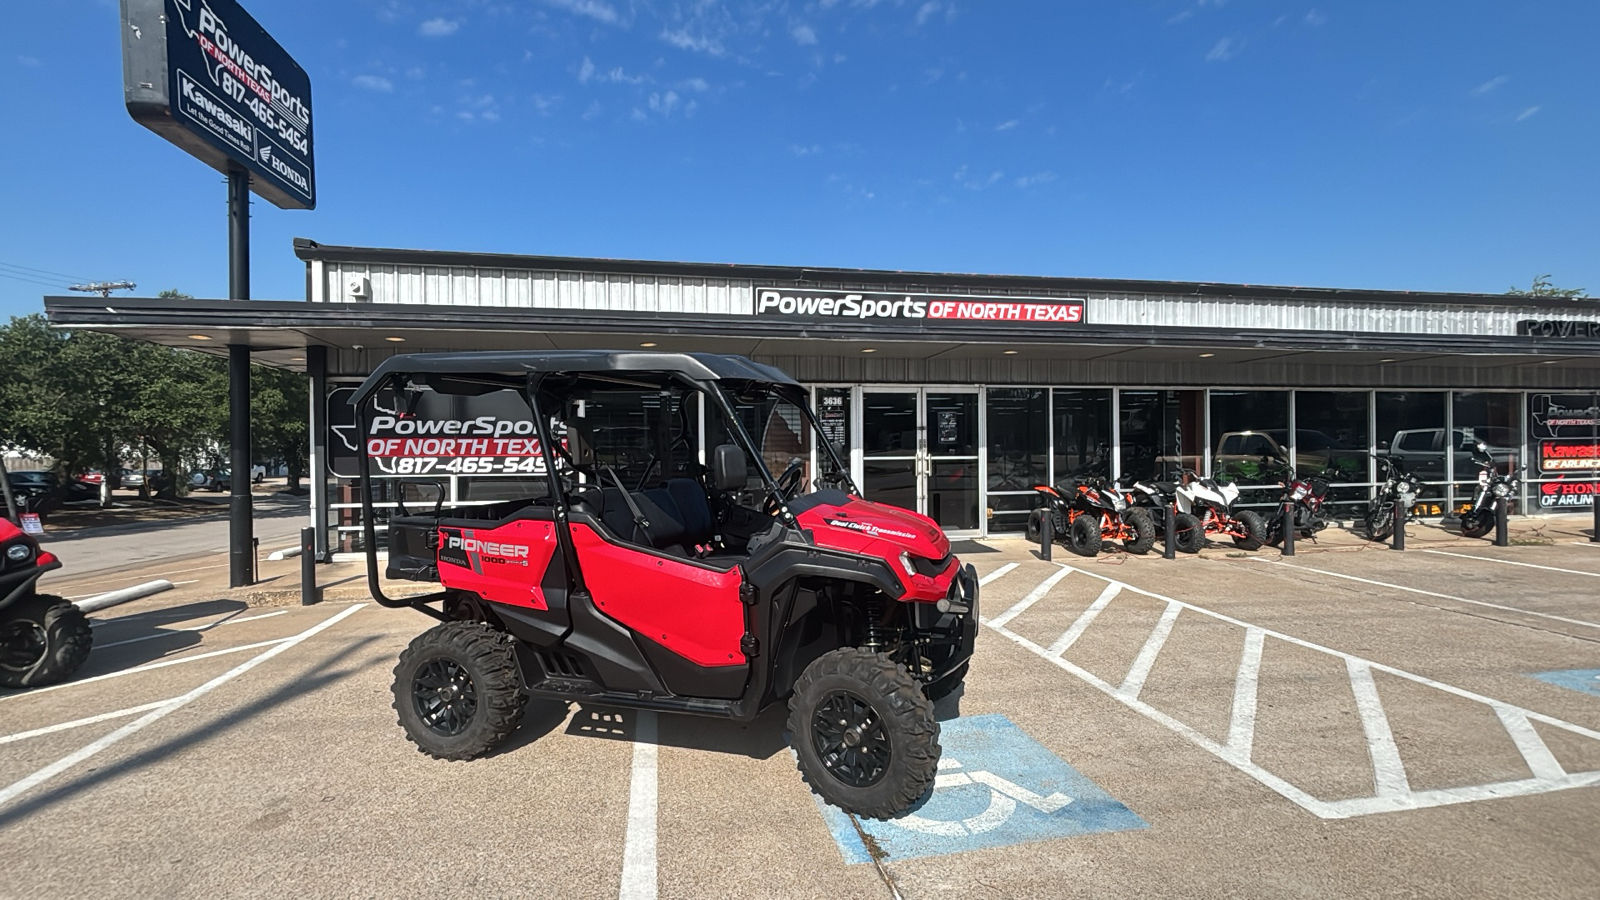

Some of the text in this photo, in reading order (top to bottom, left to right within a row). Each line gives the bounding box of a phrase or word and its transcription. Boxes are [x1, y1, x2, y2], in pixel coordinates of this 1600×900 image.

[199, 8, 309, 125] PowerSports
[200, 35, 271, 104] OF NORTH TEXAS
[182, 77, 252, 142] Kawasaki
[222, 71, 308, 156] 817-465-5454
[187, 103, 198, 117] Let
[198, 111, 208, 124] the
[208, 118, 224, 134] Good
[224, 129, 240, 146] Times
[271, 156, 309, 191] HONDA
[758, 291, 1081, 321] PowerSports OF NORTH TEXAS
[823, 397, 842, 406] 3636
[370, 416, 567, 438] PowerSpots
[367, 439, 399, 456] OF
[403, 439, 488, 456] NORTH
[1545, 459, 1600, 469] OF ARLING
[1541, 494, 1594, 506] OF ARLIN
[830, 519, 917, 539] Dual Clutch Transmission
[448, 536, 529, 558] PIONEER
[440, 555, 467, 566] HONDA
[481, 555, 506, 565] 1000
